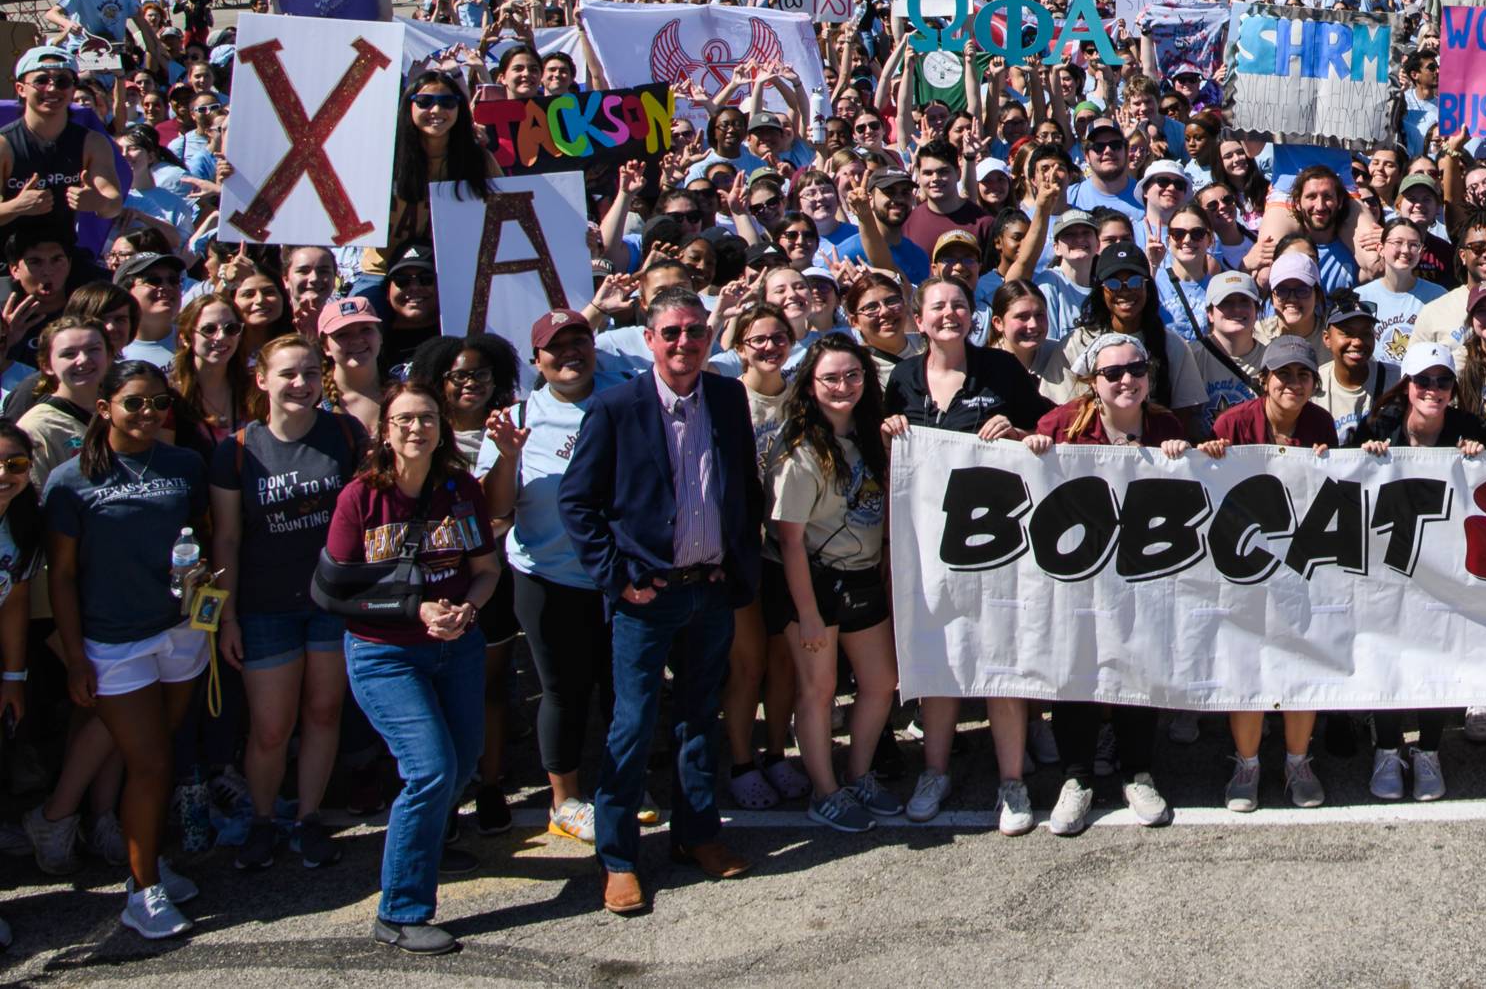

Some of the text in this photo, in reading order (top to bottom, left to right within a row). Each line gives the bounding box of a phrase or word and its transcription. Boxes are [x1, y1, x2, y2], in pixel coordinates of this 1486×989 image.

[1236, 16, 1391, 83] SHRM
[228, 37, 392, 246] X
[474, 90, 675, 168] JACKSON
[467, 191, 570, 336] A
[95, 478, 187, 499] TEXAS STATE
[258, 471, 299, 491] DON'T
[258, 474, 342, 506] TALK TO ME
[266, 512, 285, 524] I'M
[269, 511, 329, 533] COUNTING
[939, 466, 1454, 585] BOBCAT
